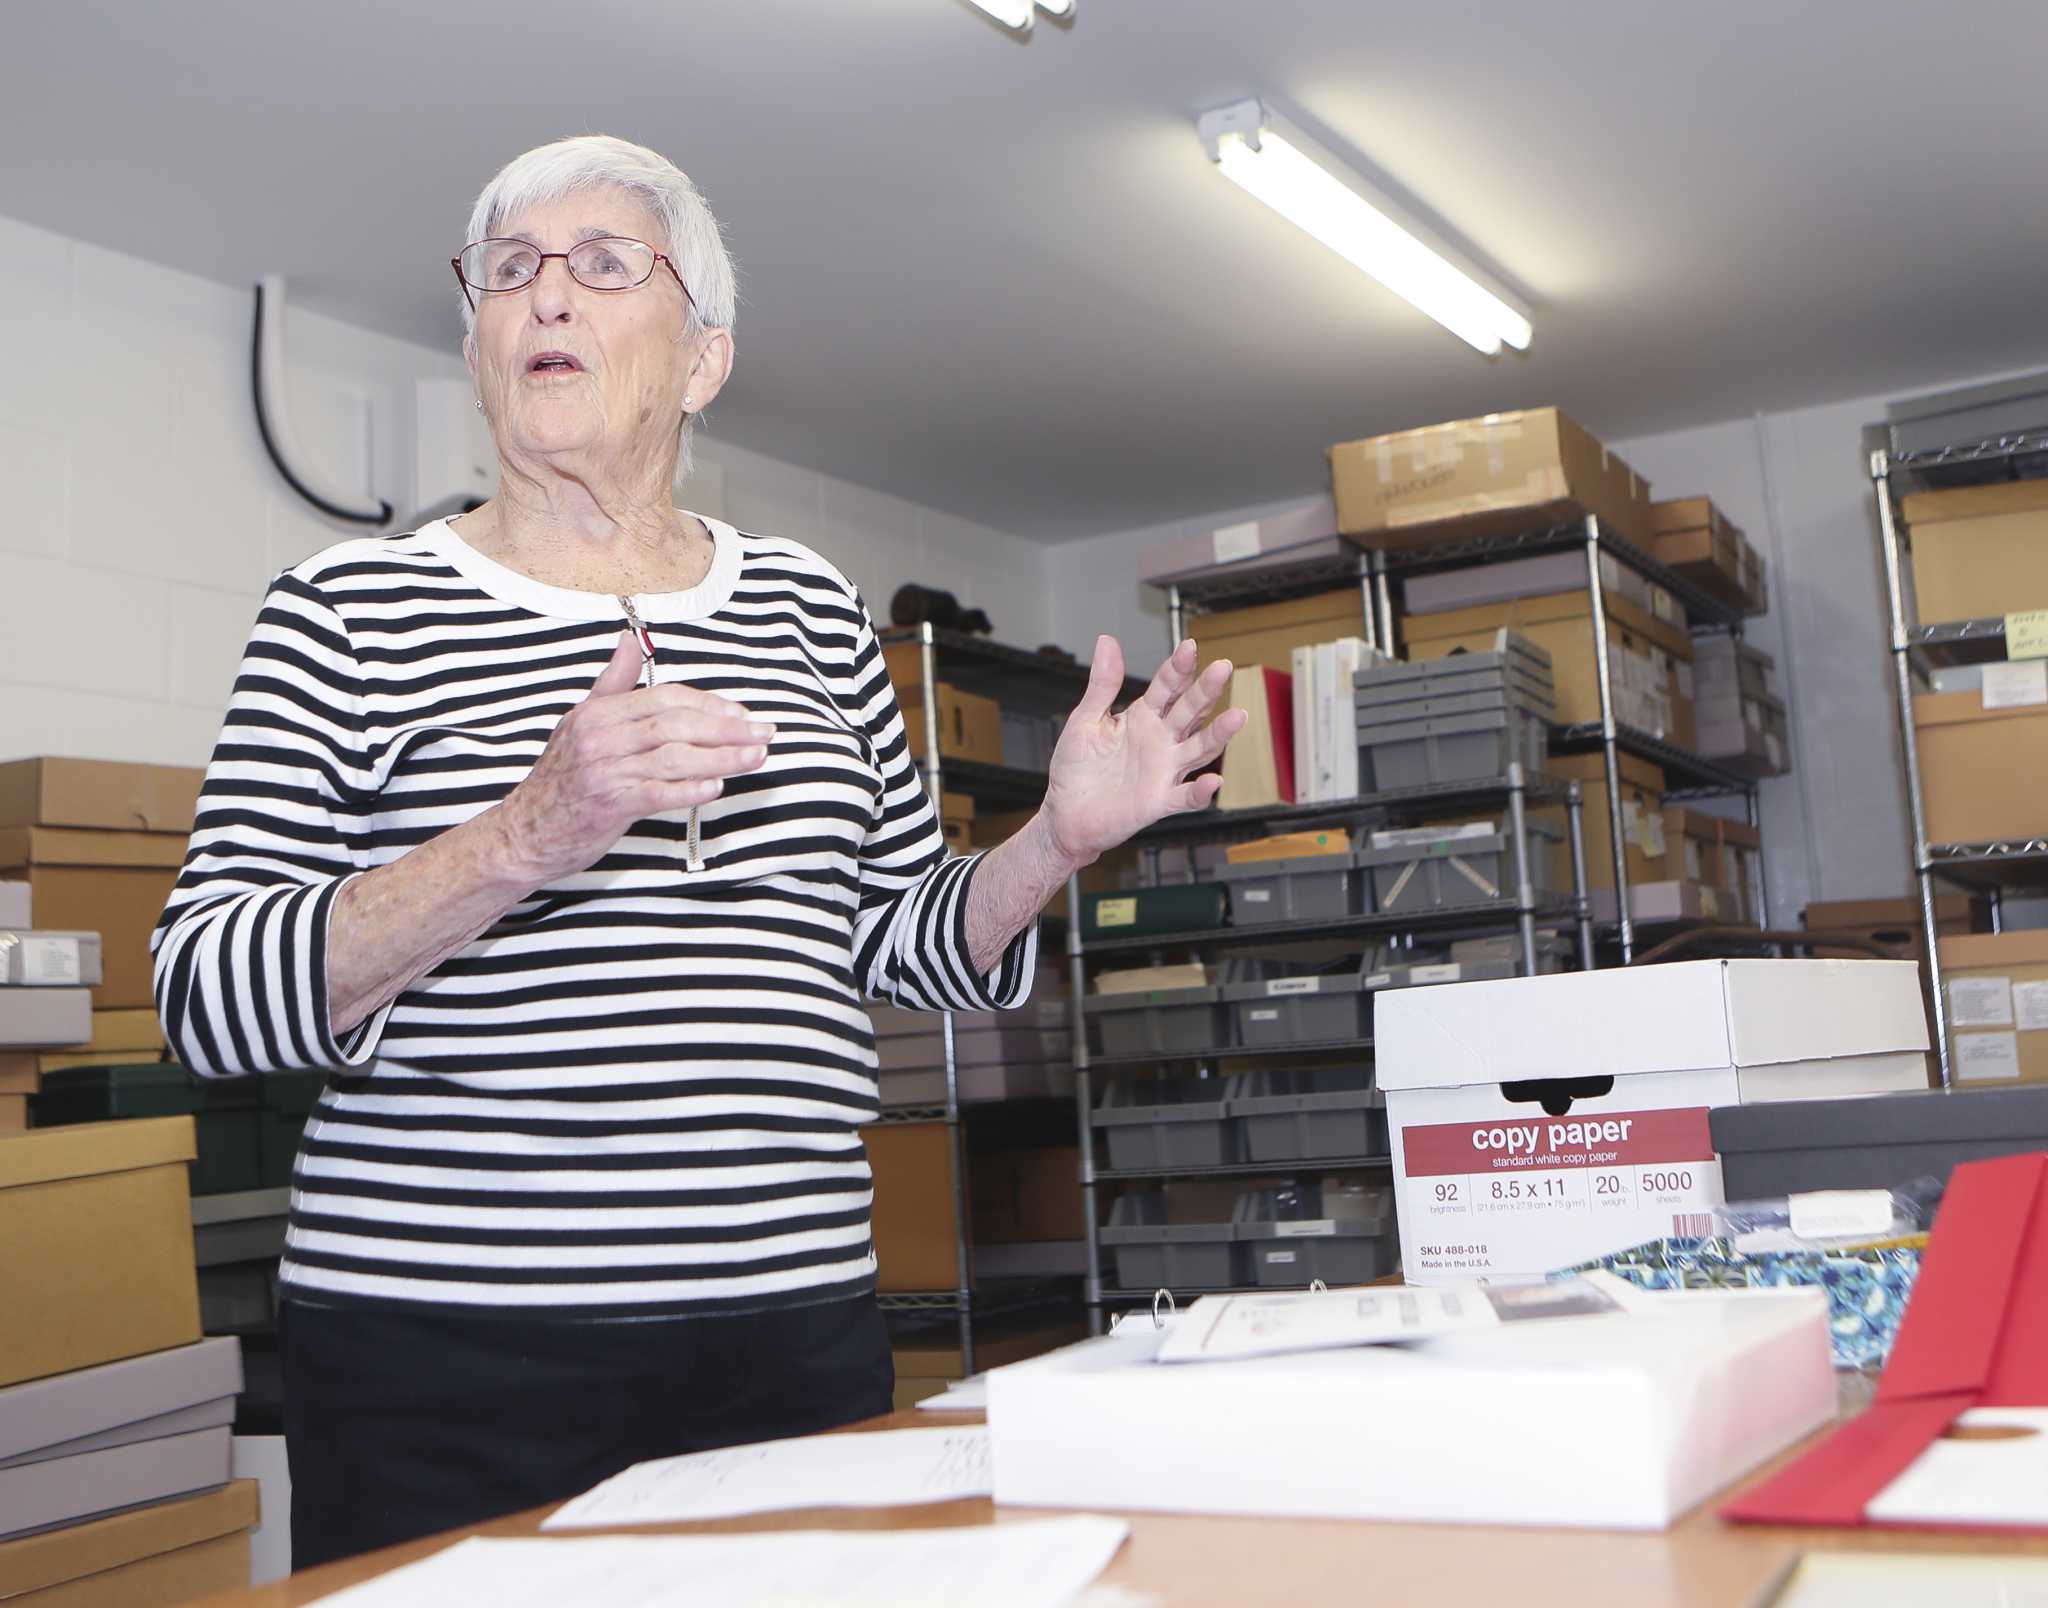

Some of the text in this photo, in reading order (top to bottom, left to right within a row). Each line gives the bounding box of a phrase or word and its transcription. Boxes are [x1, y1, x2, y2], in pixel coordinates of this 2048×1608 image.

[1472, 1119, 1632, 1154] copy paper
[1492, 1151, 1618, 1168] standard white copy paper
[1491, 1178, 1565, 1199] 8.5 x 11
[1595, 1175, 1620, 1194] 20
[1642, 1171, 1692, 1192] 5000
[1435, 1183, 1458, 1202] 92
[1420, 1244, 1488, 1256] SKU 488-018
[1421, 1260, 1443, 1269] Made
[1444, 1260, 1452, 1268] in
[1454, 1259, 1466, 1268] the
